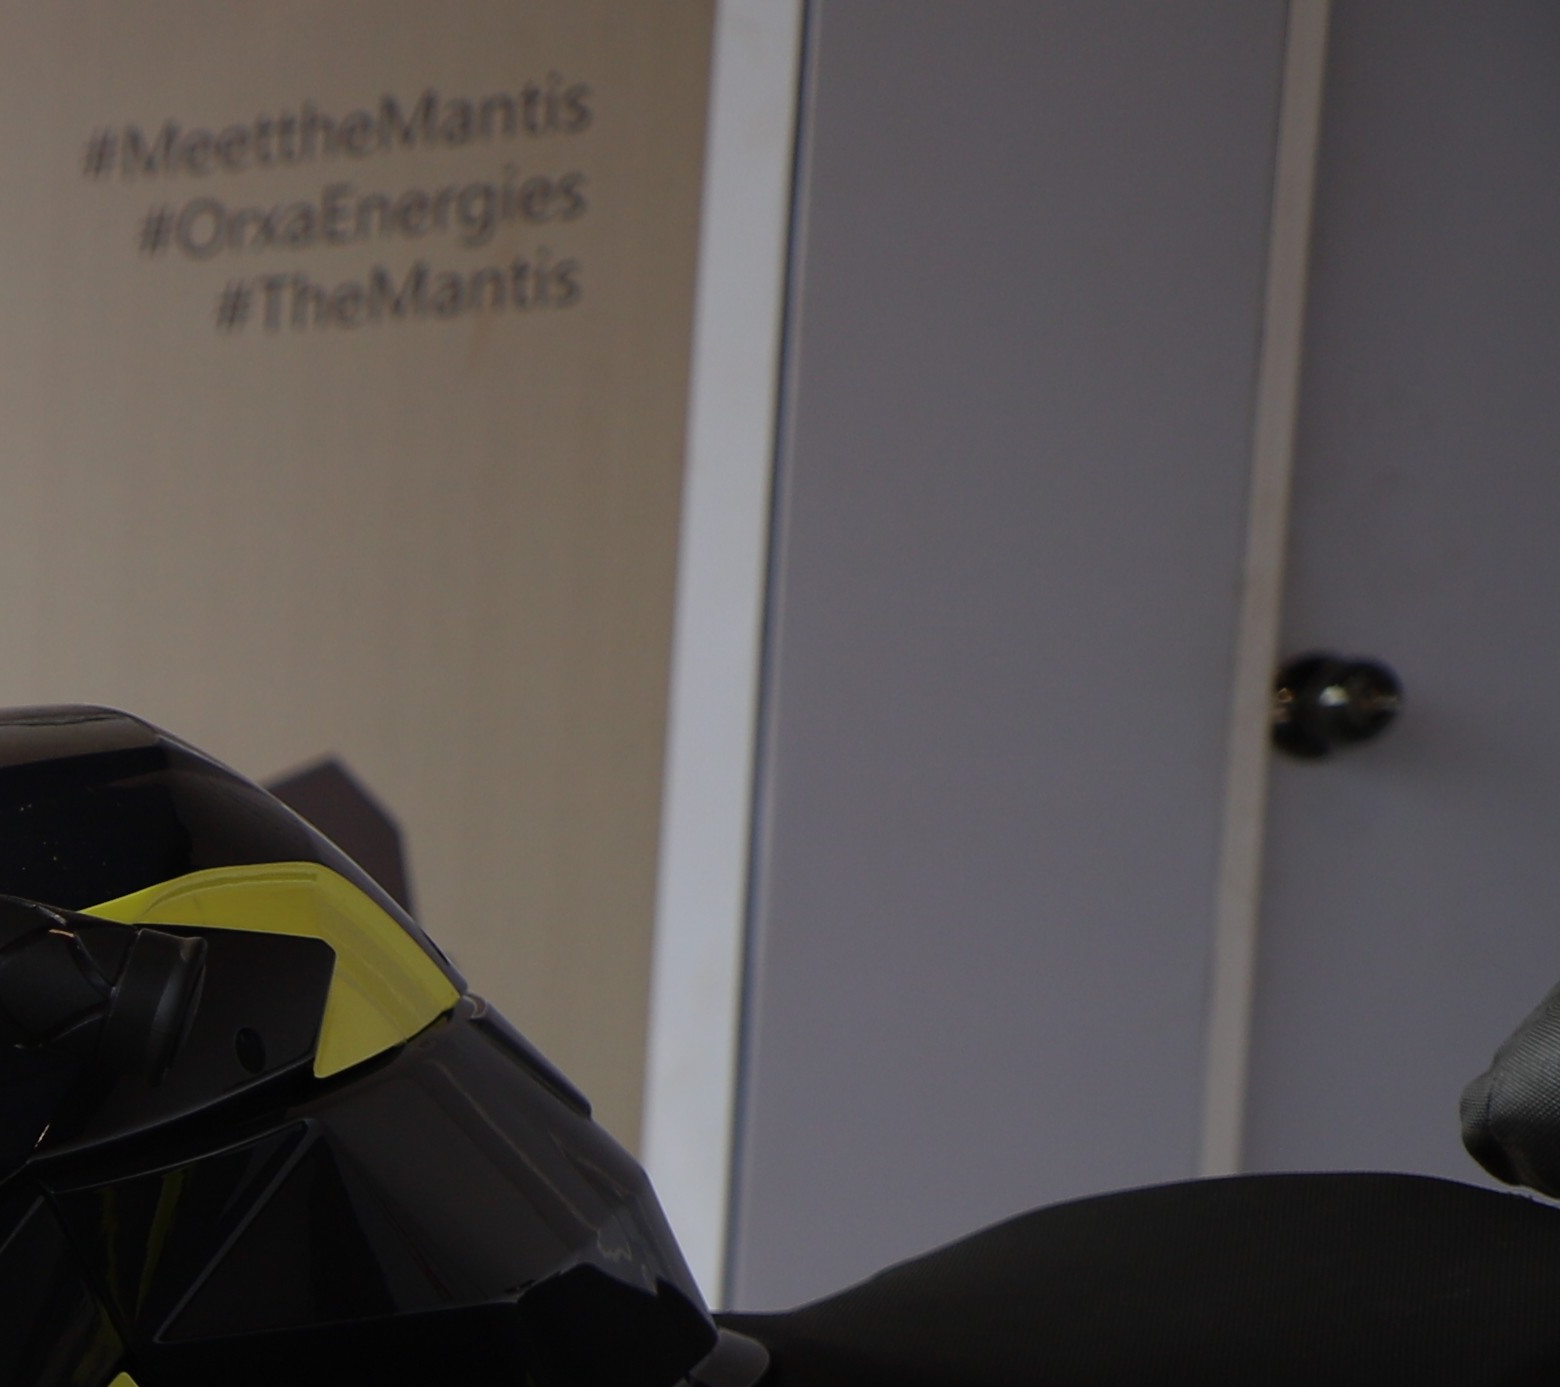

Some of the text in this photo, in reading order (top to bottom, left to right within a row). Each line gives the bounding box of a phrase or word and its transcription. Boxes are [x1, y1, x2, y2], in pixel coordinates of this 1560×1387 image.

[84, 72, 592, 178] #MeettheMantis
[138, 164, 587, 260] #OrxaEnergies
[217, 246, 584, 334] #TheMantis
